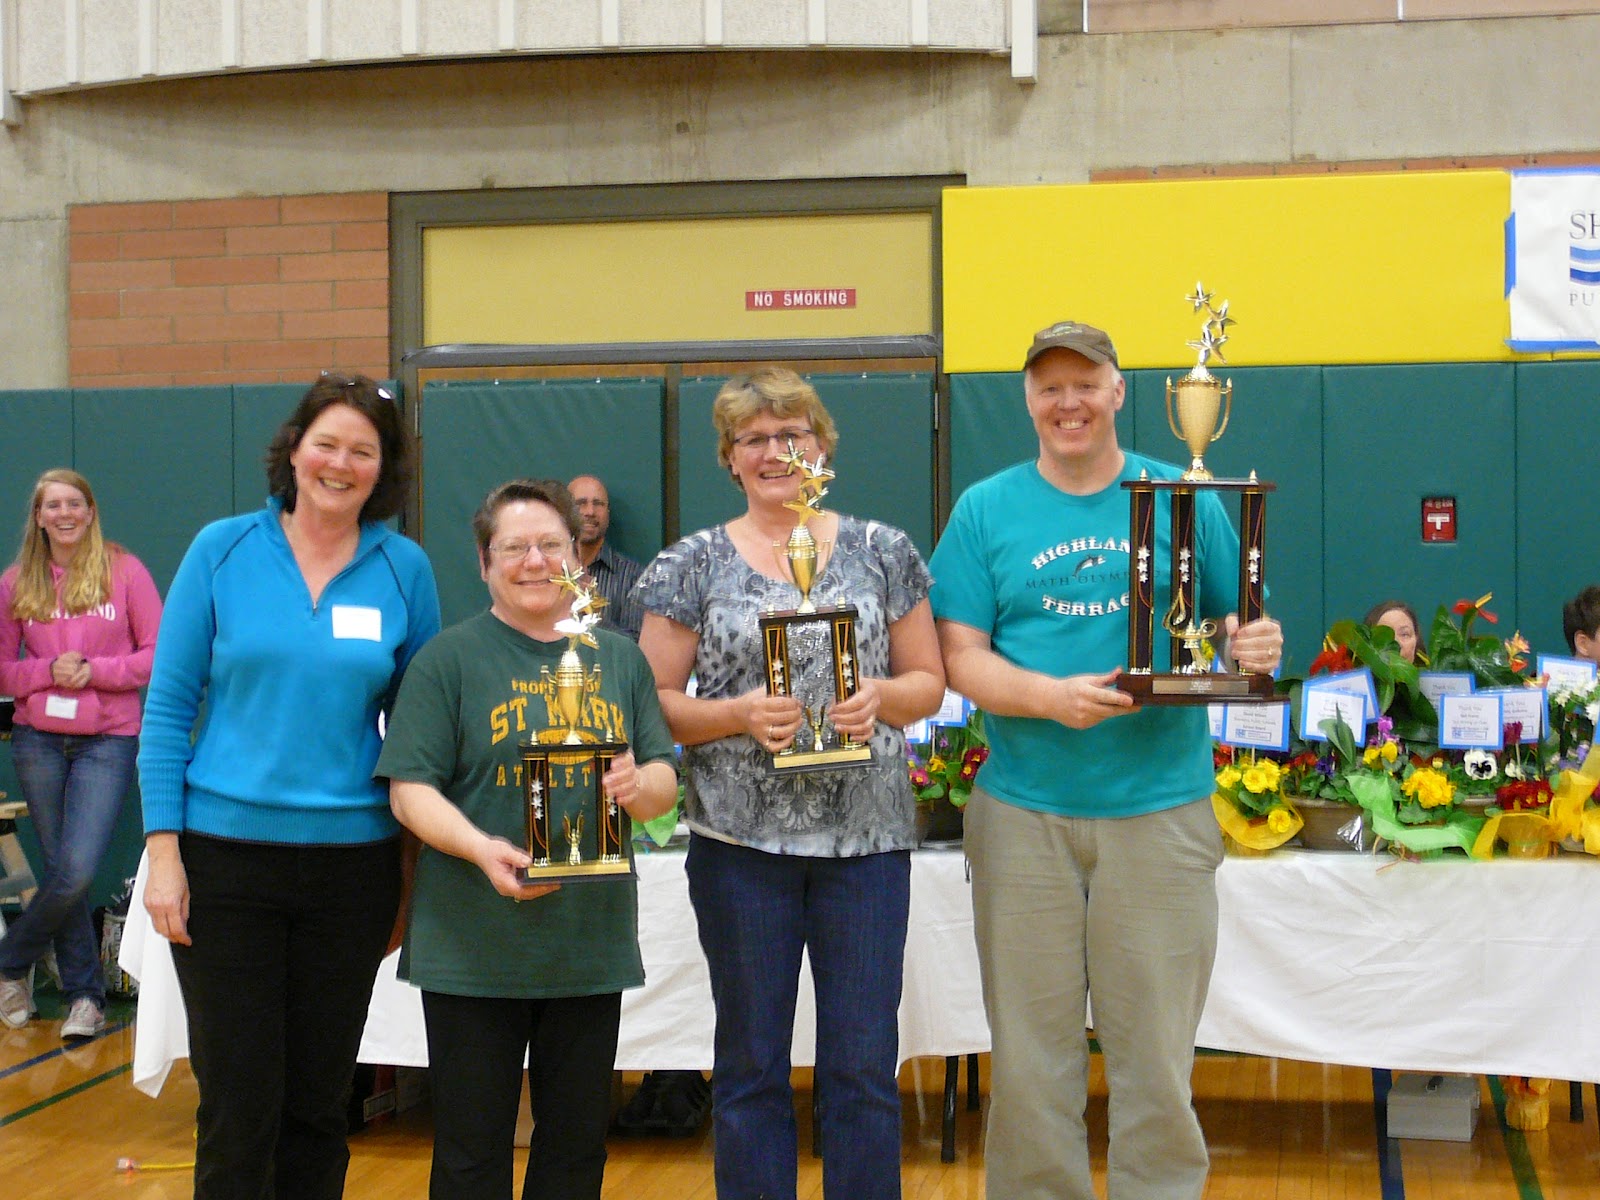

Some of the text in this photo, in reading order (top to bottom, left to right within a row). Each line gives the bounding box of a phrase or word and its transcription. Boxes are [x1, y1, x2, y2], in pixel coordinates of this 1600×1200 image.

[754, 289, 848, 307] NO SMOKING
[1031, 535, 1130, 570] HIGHLAN
[1025, 575, 1070, 589] MATH
[1042, 591, 1130, 617] TERRAC
[490, 695, 529, 746] ST
